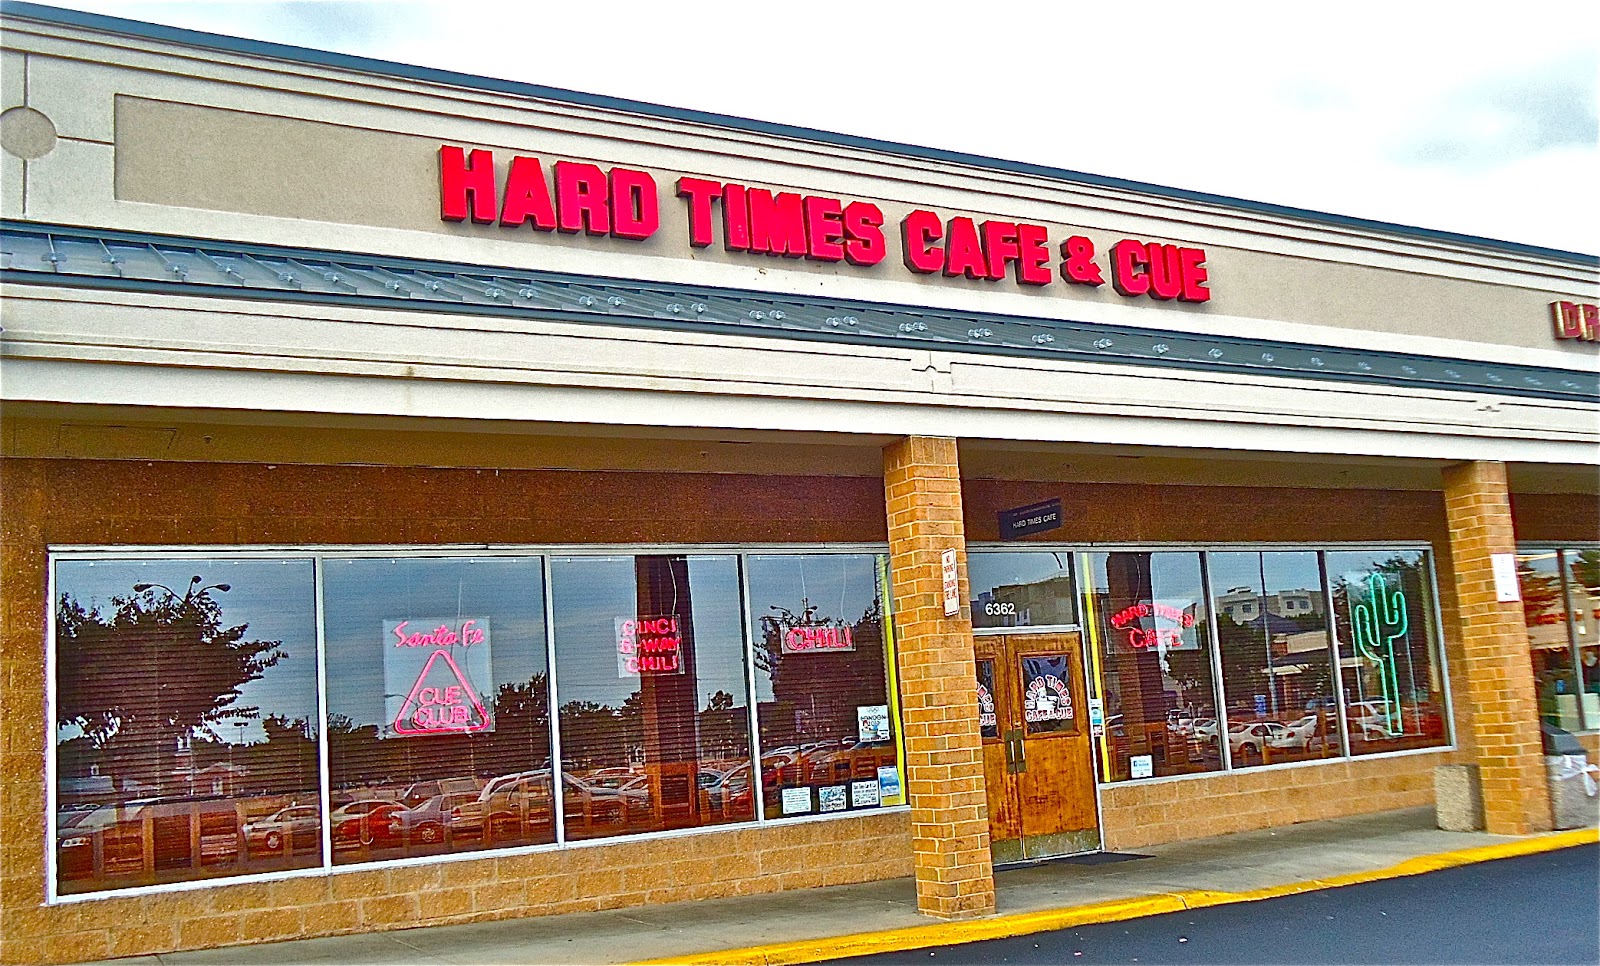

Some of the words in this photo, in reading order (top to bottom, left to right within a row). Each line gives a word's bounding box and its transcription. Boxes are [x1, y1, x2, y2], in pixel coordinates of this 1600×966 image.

[439, 144, 660, 240] HARD
[676, 176, 886, 266] TIMES
[900, 209, 1052, 286] CAFE
[1060, 235, 1105, 287] &
[1108, 239, 1211, 302] CUE
[1012, 519, 1026, 529] HARD
[1027, 516, 1042, 526] TIMES
[1043, 513, 1057, 523] CAFE
[985, 602, 1016, 616] 6362
[393, 620, 460, 648] Santa
[462, 620, 485, 647] Fe
[622, 618, 677, 636] CINCI
[786, 626, 853, 651] CHILI
[1129, 628, 1184, 648] CAFE
[626, 655, 678, 673] CHILI
[418, 685, 463, 707] CUE
[412, 705, 469, 728] CLUB
[1025, 709, 1048, 722] CAFE
[1055, 707, 1074, 720] CUE
